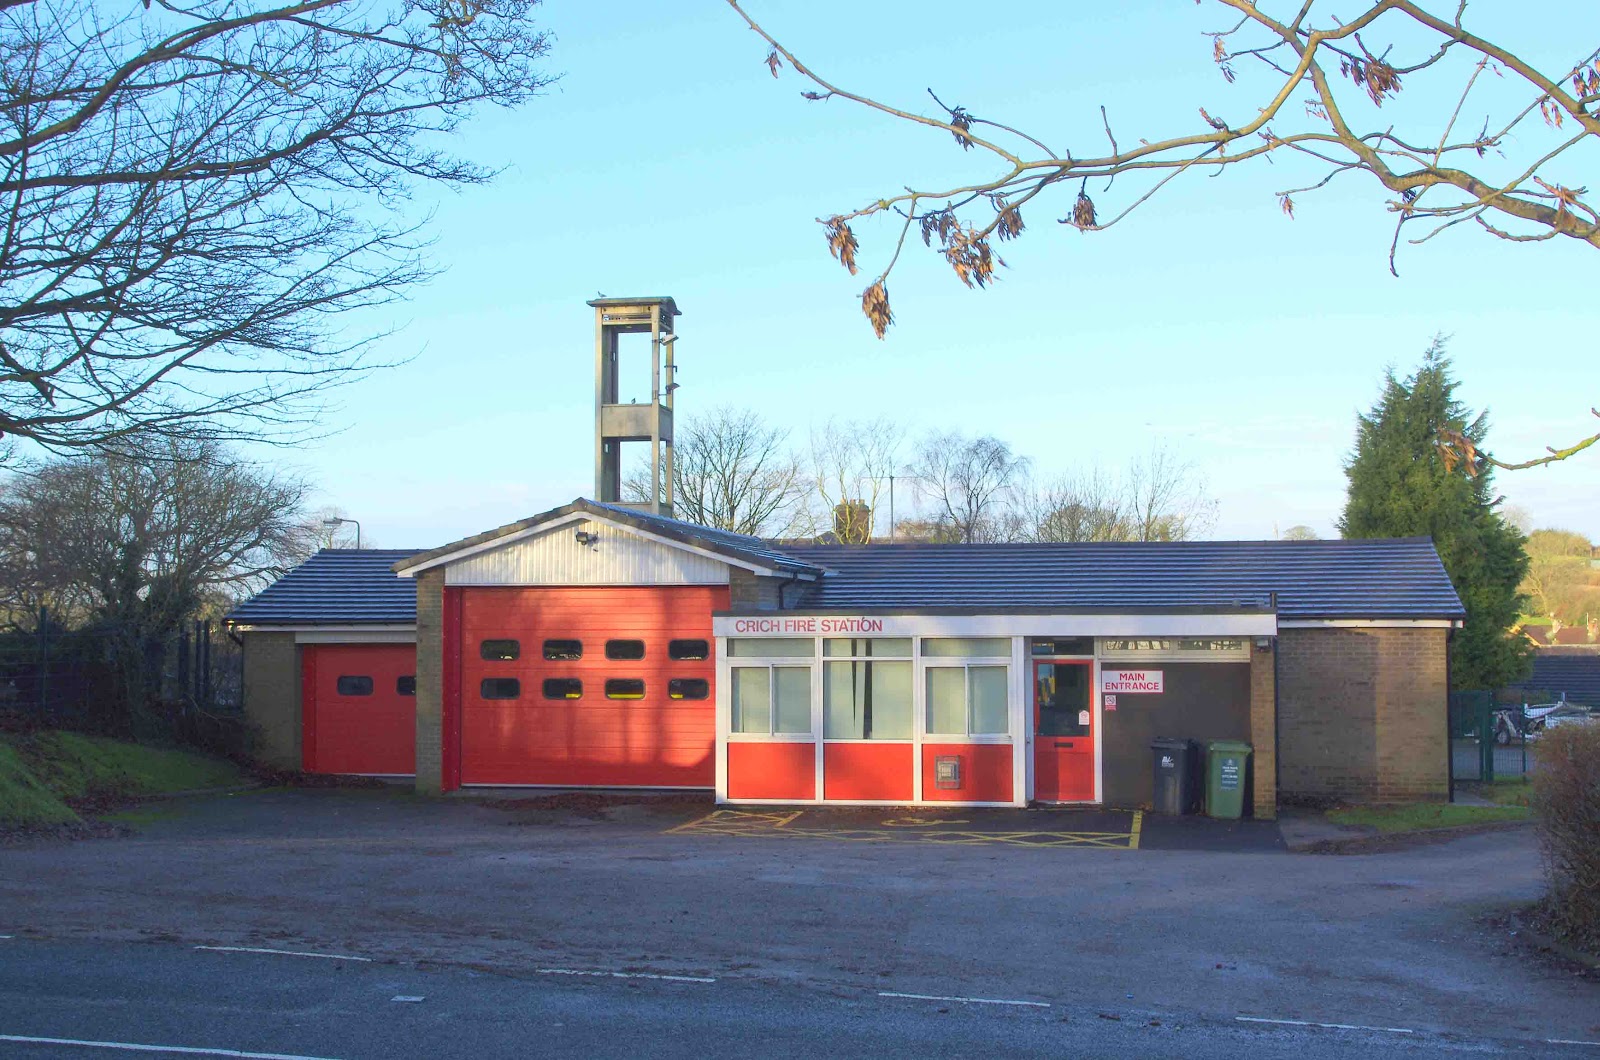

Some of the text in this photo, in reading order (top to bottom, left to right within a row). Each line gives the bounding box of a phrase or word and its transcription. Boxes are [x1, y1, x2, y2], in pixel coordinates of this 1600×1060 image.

[735, 619, 883, 633] CRICH FIRE STATION
[1119, 673, 1145, 681] MAIN
[1105, 682, 1160, 690] ENTRANCE
